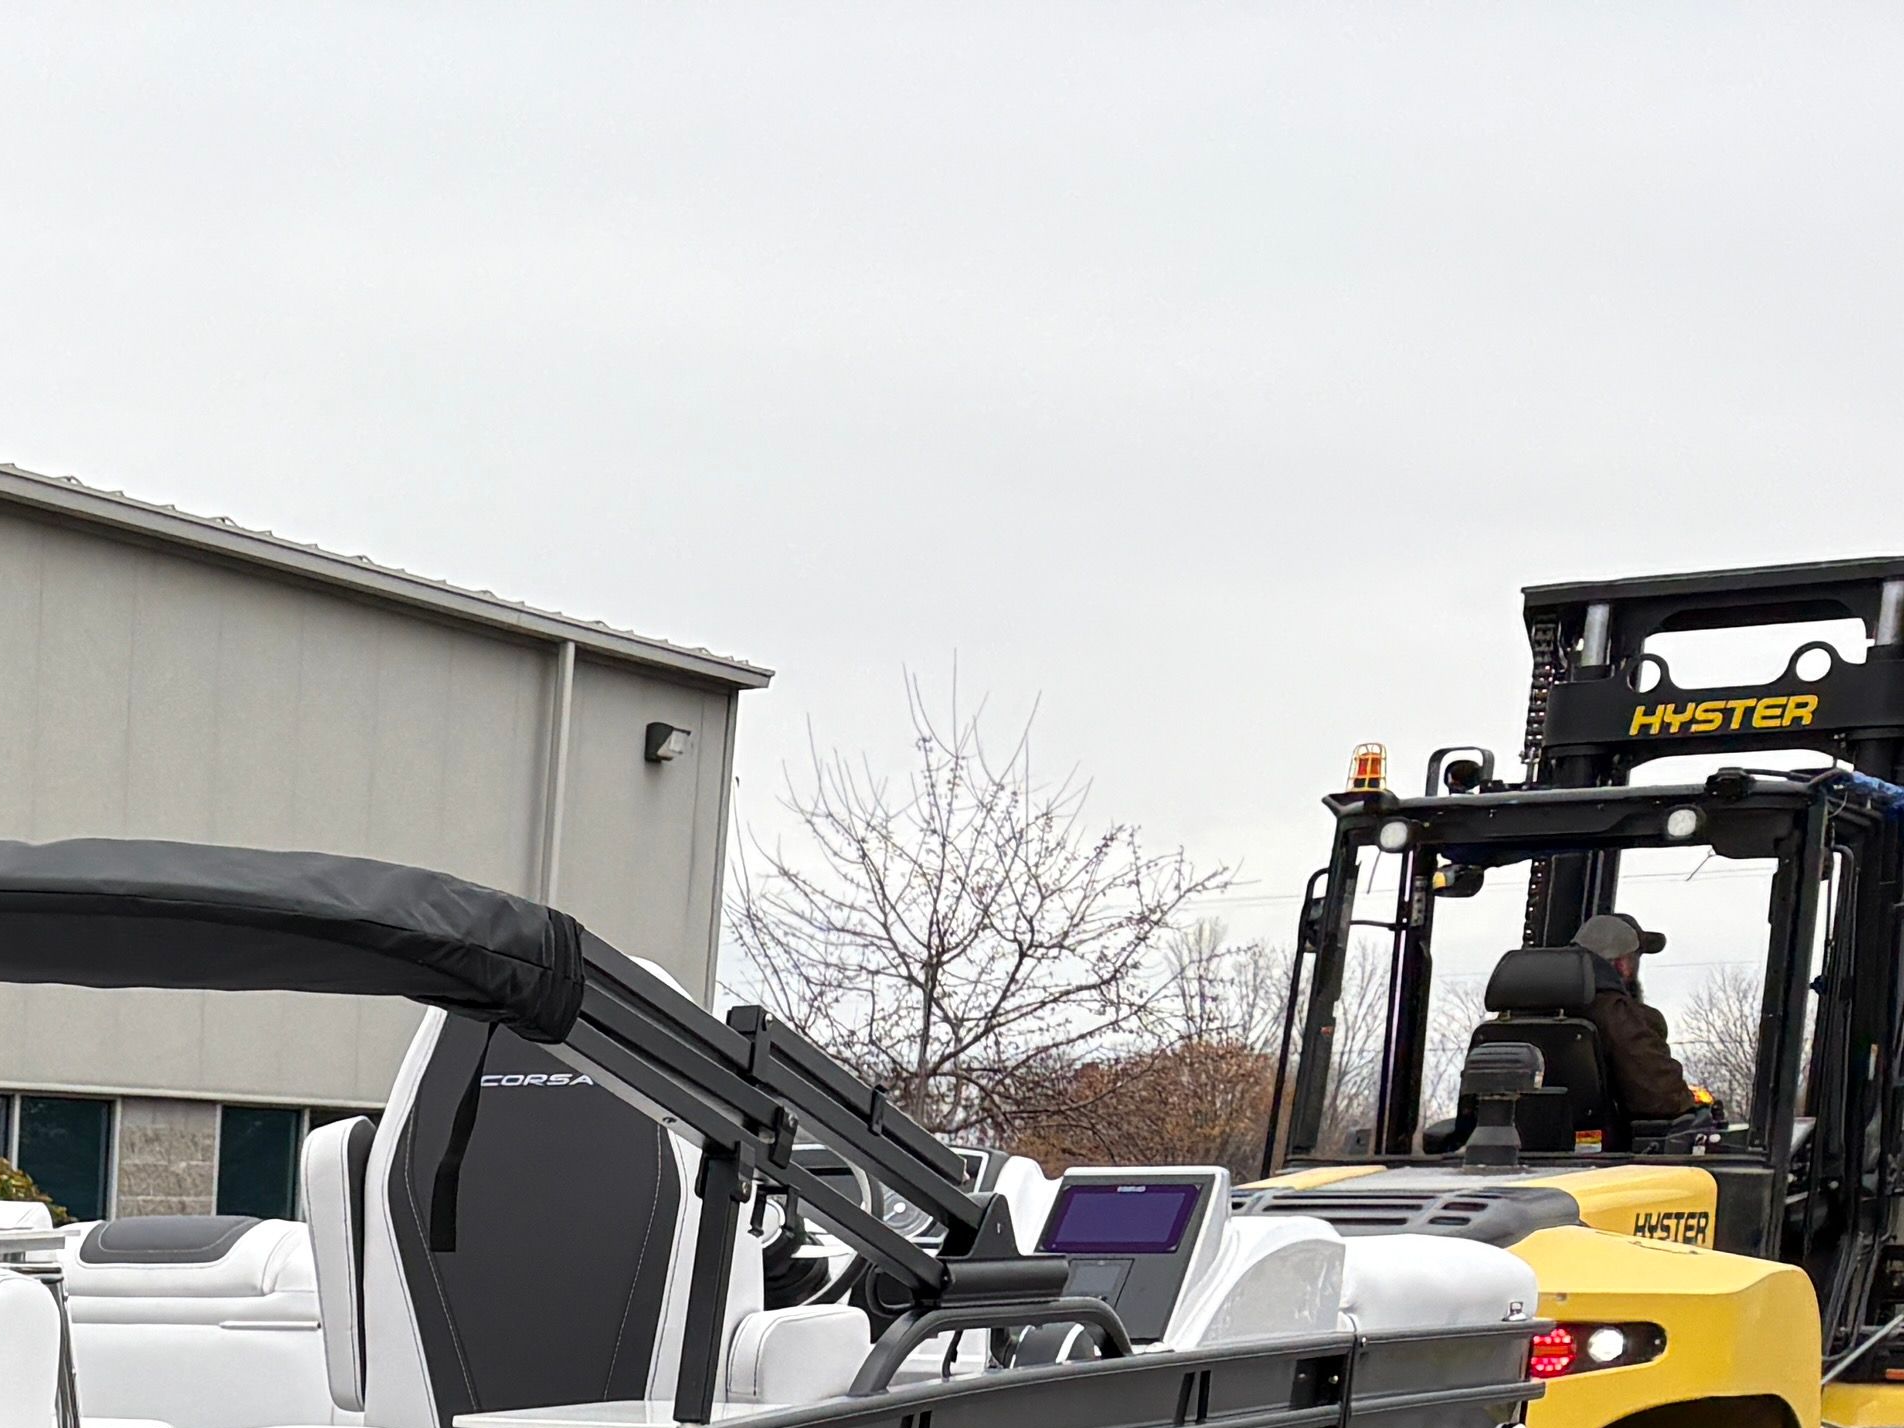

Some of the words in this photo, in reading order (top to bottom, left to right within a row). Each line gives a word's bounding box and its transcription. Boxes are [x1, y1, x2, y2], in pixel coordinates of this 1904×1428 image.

[1628, 694, 1818, 736] HYSTER
[480, 1073, 594, 1087] CORSA
[1633, 1211, 1709, 1244] HYSTER
